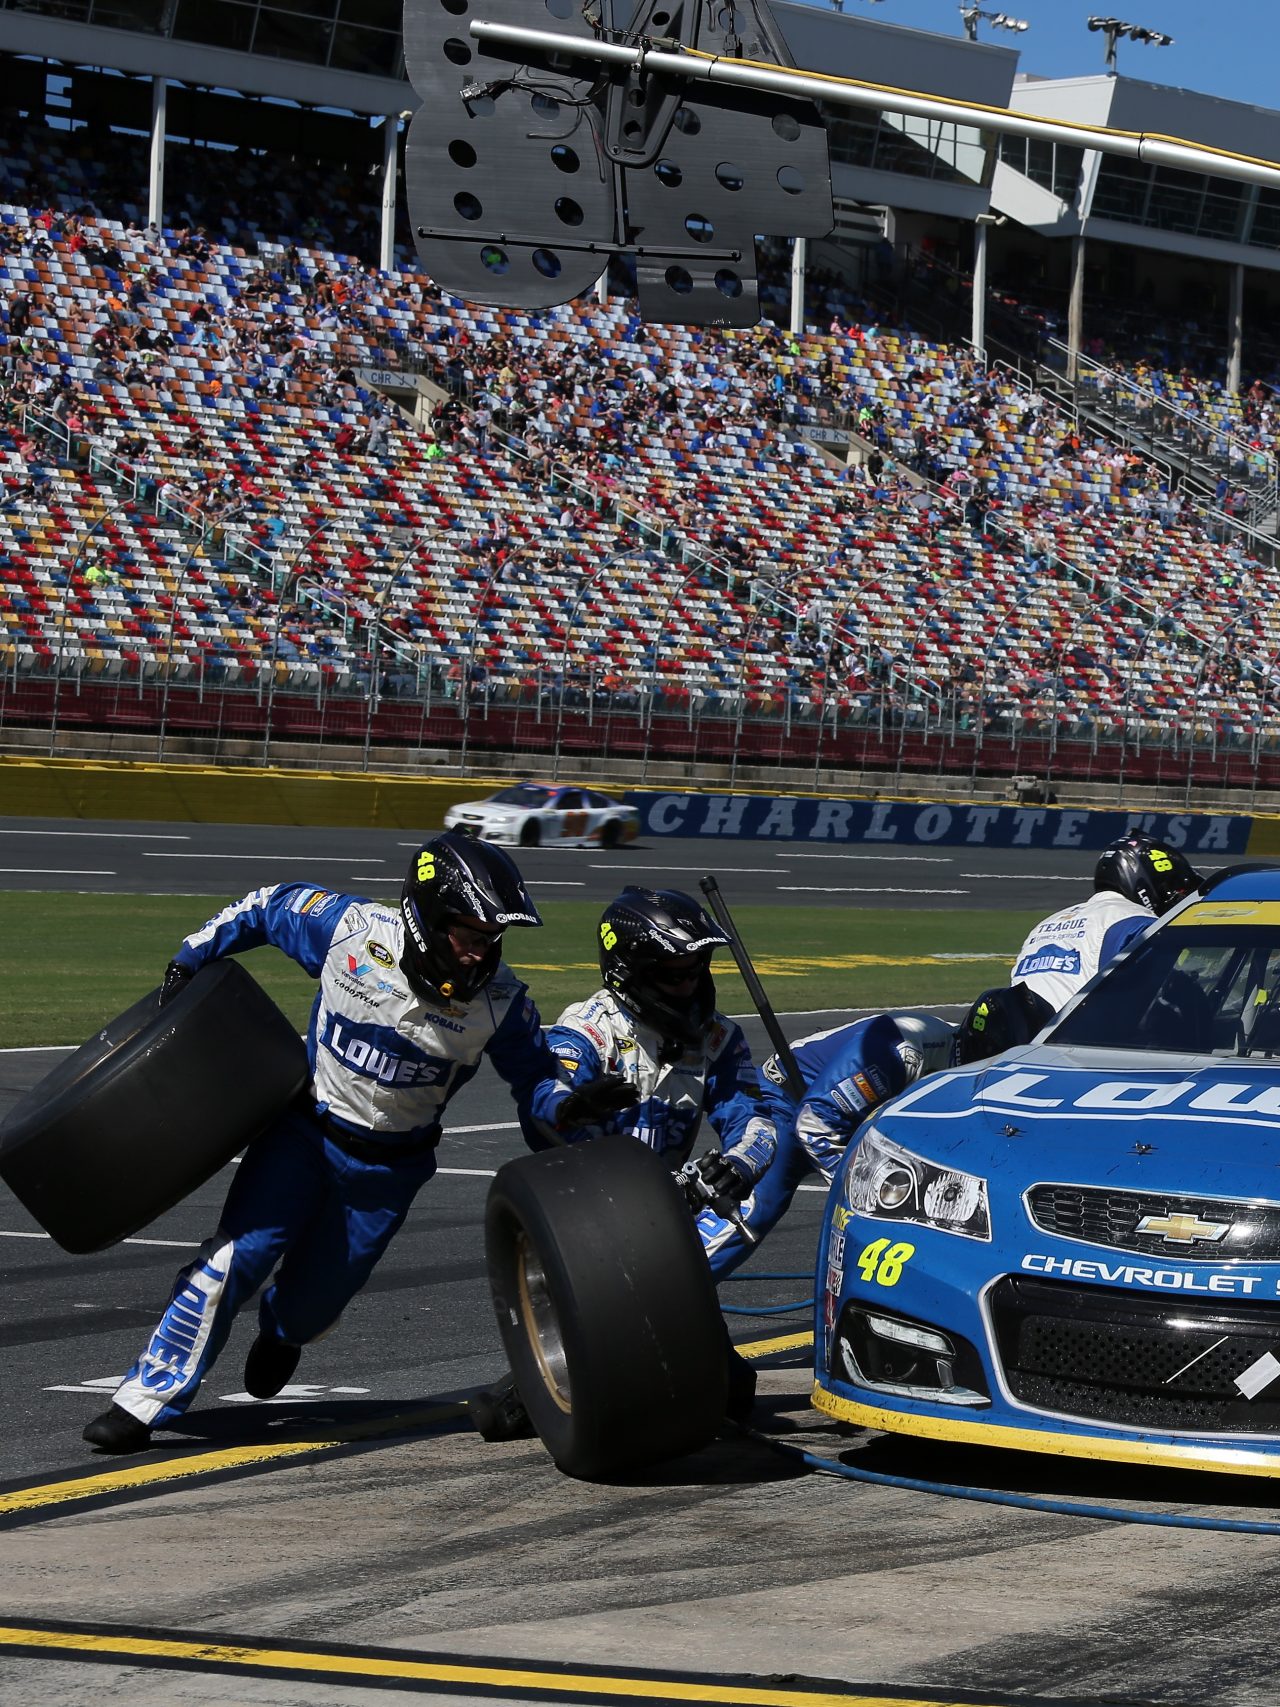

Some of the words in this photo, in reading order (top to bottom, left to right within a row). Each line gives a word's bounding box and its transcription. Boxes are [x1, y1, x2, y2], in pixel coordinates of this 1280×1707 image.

[371, 372, 392, 385] CHR
[399, 375, 405, 386] J
[810, 428, 827, 440] CHR
[647, 795, 1091, 847] CHARLOTTE
[417, 851, 436, 882] 48
[1149, 849, 1173, 873] 48
[370, 912, 400, 927] KOBALT
[402, 896, 428, 953] LOWE'S
[507, 912, 538, 923] KOBALT
[1038, 917, 1088, 934] TEAGUE
[600, 922, 618, 951] 48
[697, 936, 728, 948] KOBALT
[1020, 955, 1078, 975] LOWE'S
[334, 978, 381, 1008] GOODYEAR
[424, 1012, 467, 1034] KOBALT
[972, 1002, 989, 1032] 48
[330, 1022, 441, 1083] LOWE'S
[857, 1237, 916, 1287] 48
[1021, 1253, 1262, 1294] CHEVROLET
